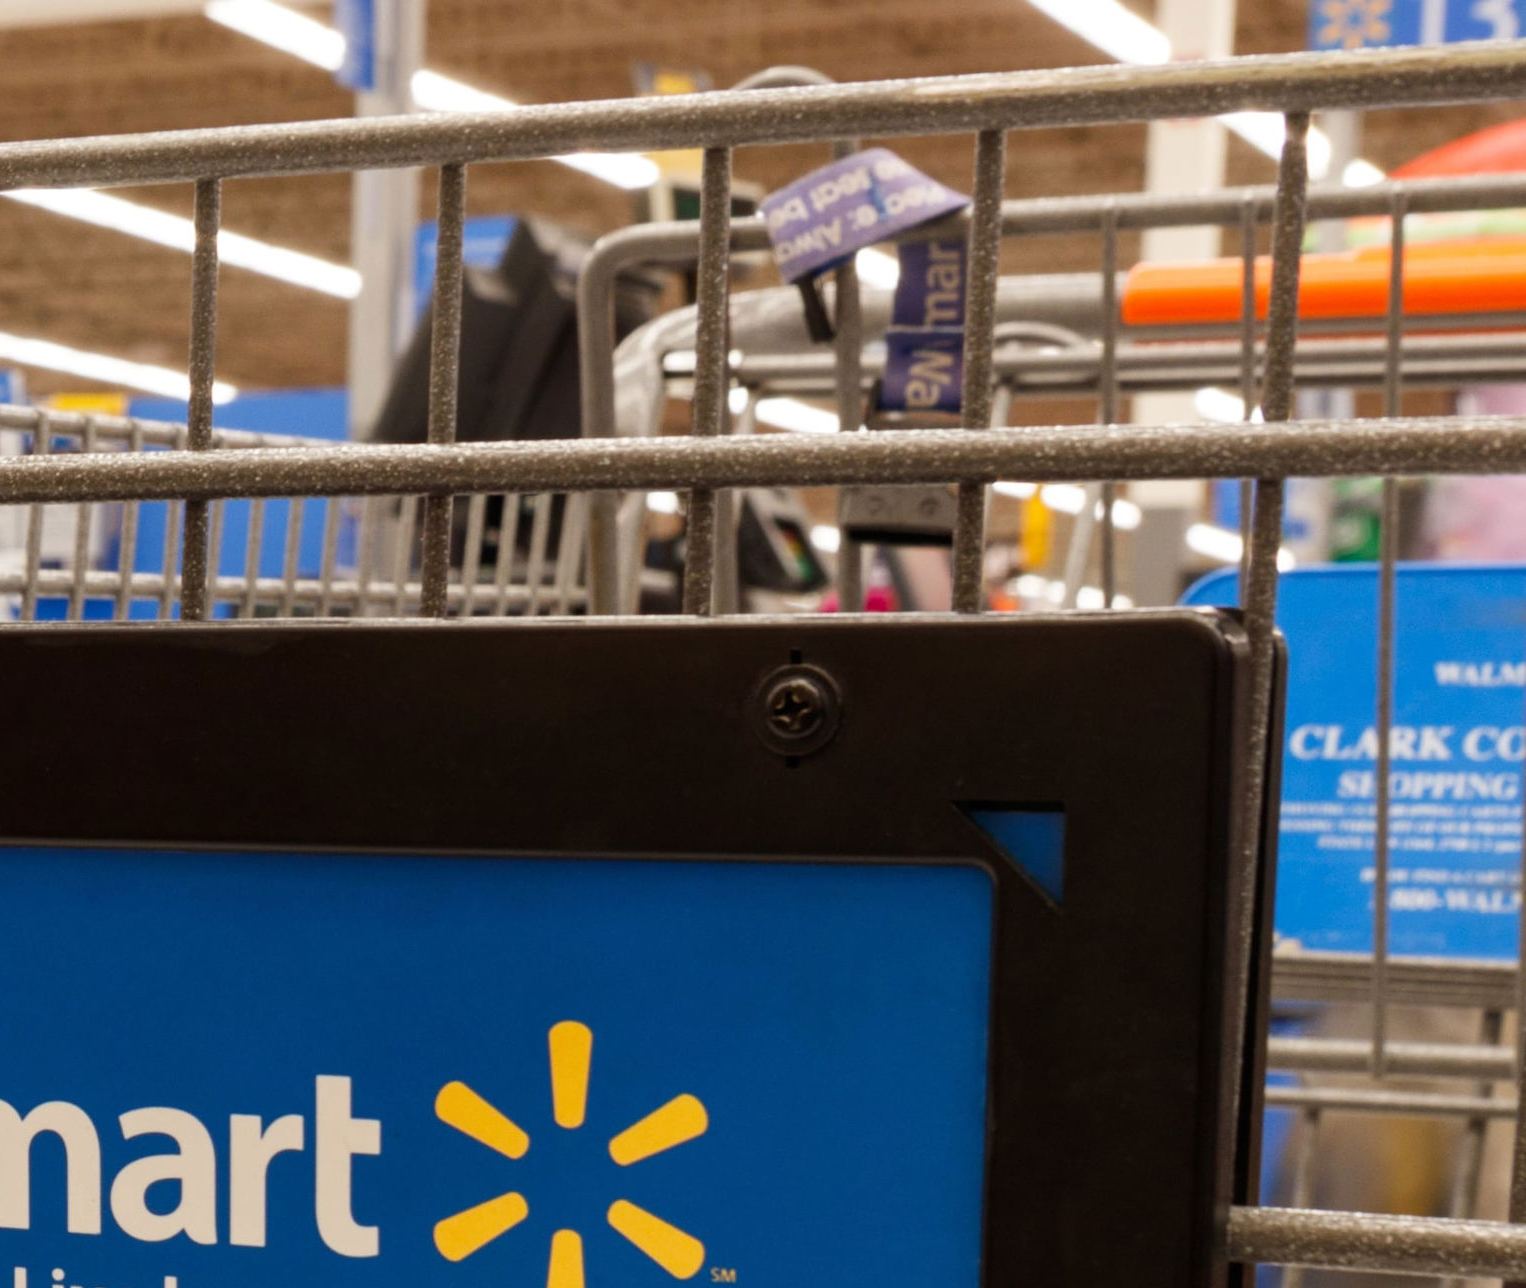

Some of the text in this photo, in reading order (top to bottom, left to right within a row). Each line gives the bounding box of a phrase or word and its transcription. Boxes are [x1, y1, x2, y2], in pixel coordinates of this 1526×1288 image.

[1435, 661, 1526, 687] WALM
[1289, 725, 1454, 761] CLARK
[710, 1267, 737, 1283] SM
